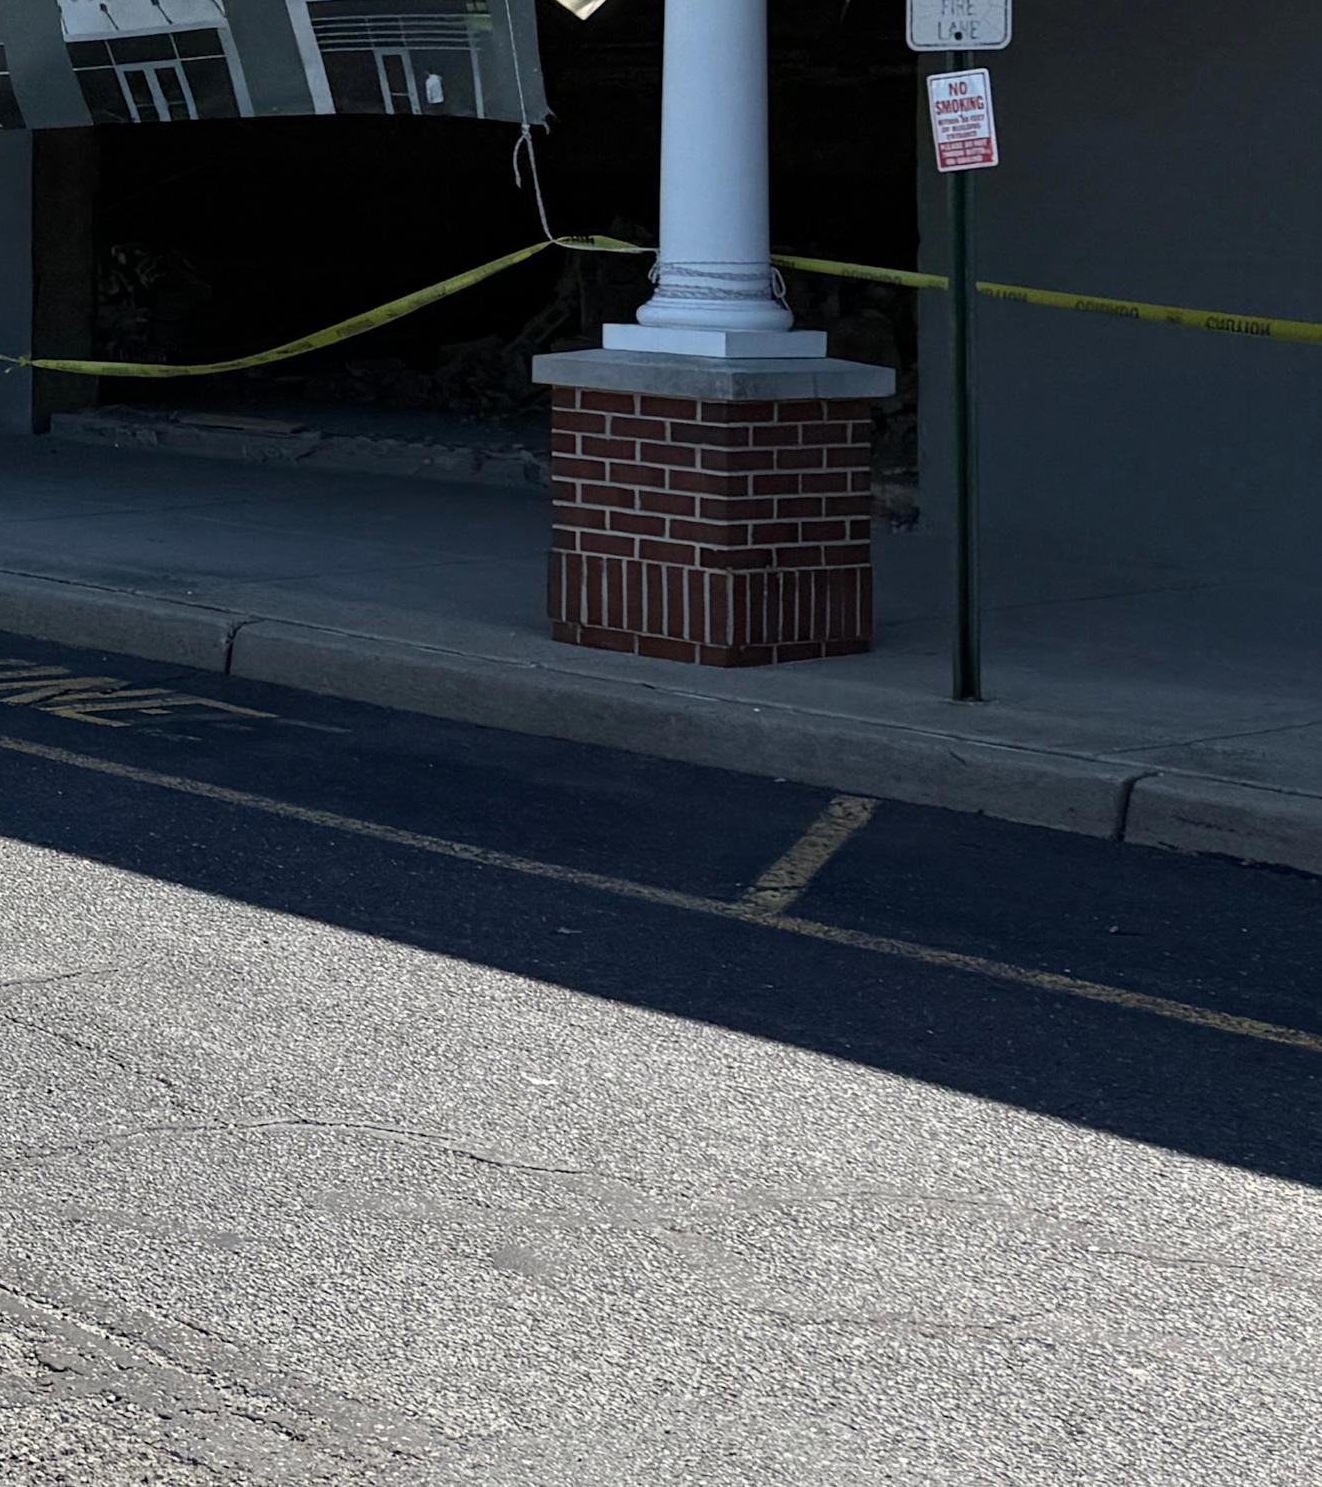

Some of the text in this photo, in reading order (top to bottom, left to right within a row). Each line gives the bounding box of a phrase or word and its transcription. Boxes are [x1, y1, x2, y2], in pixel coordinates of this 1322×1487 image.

[938, 20, 981, 41] LANE
[949, 82, 968, 96] NO
[935, 96, 985, 115] SMOKING
